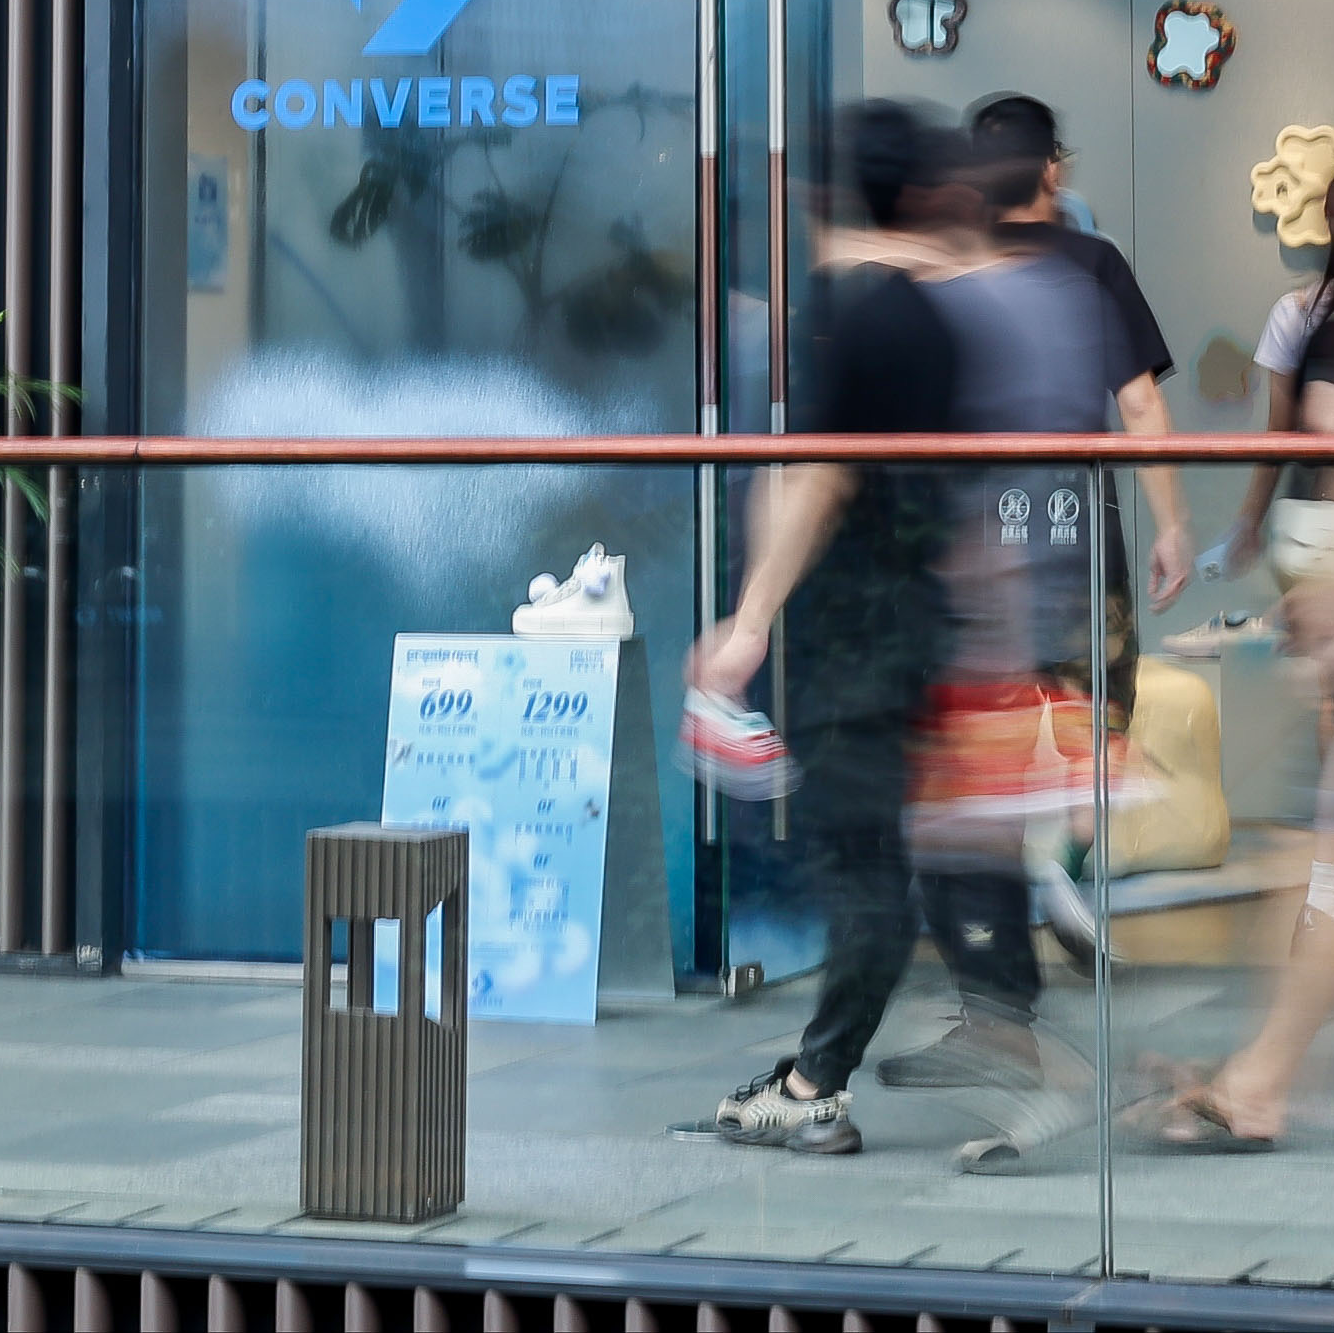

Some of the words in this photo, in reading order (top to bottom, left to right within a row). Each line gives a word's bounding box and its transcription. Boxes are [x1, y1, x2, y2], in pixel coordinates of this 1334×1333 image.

[230, 73, 581, 131] CONVERSE
[419, 688, 474, 723] 699
[522, 690, 589, 725] 1299
